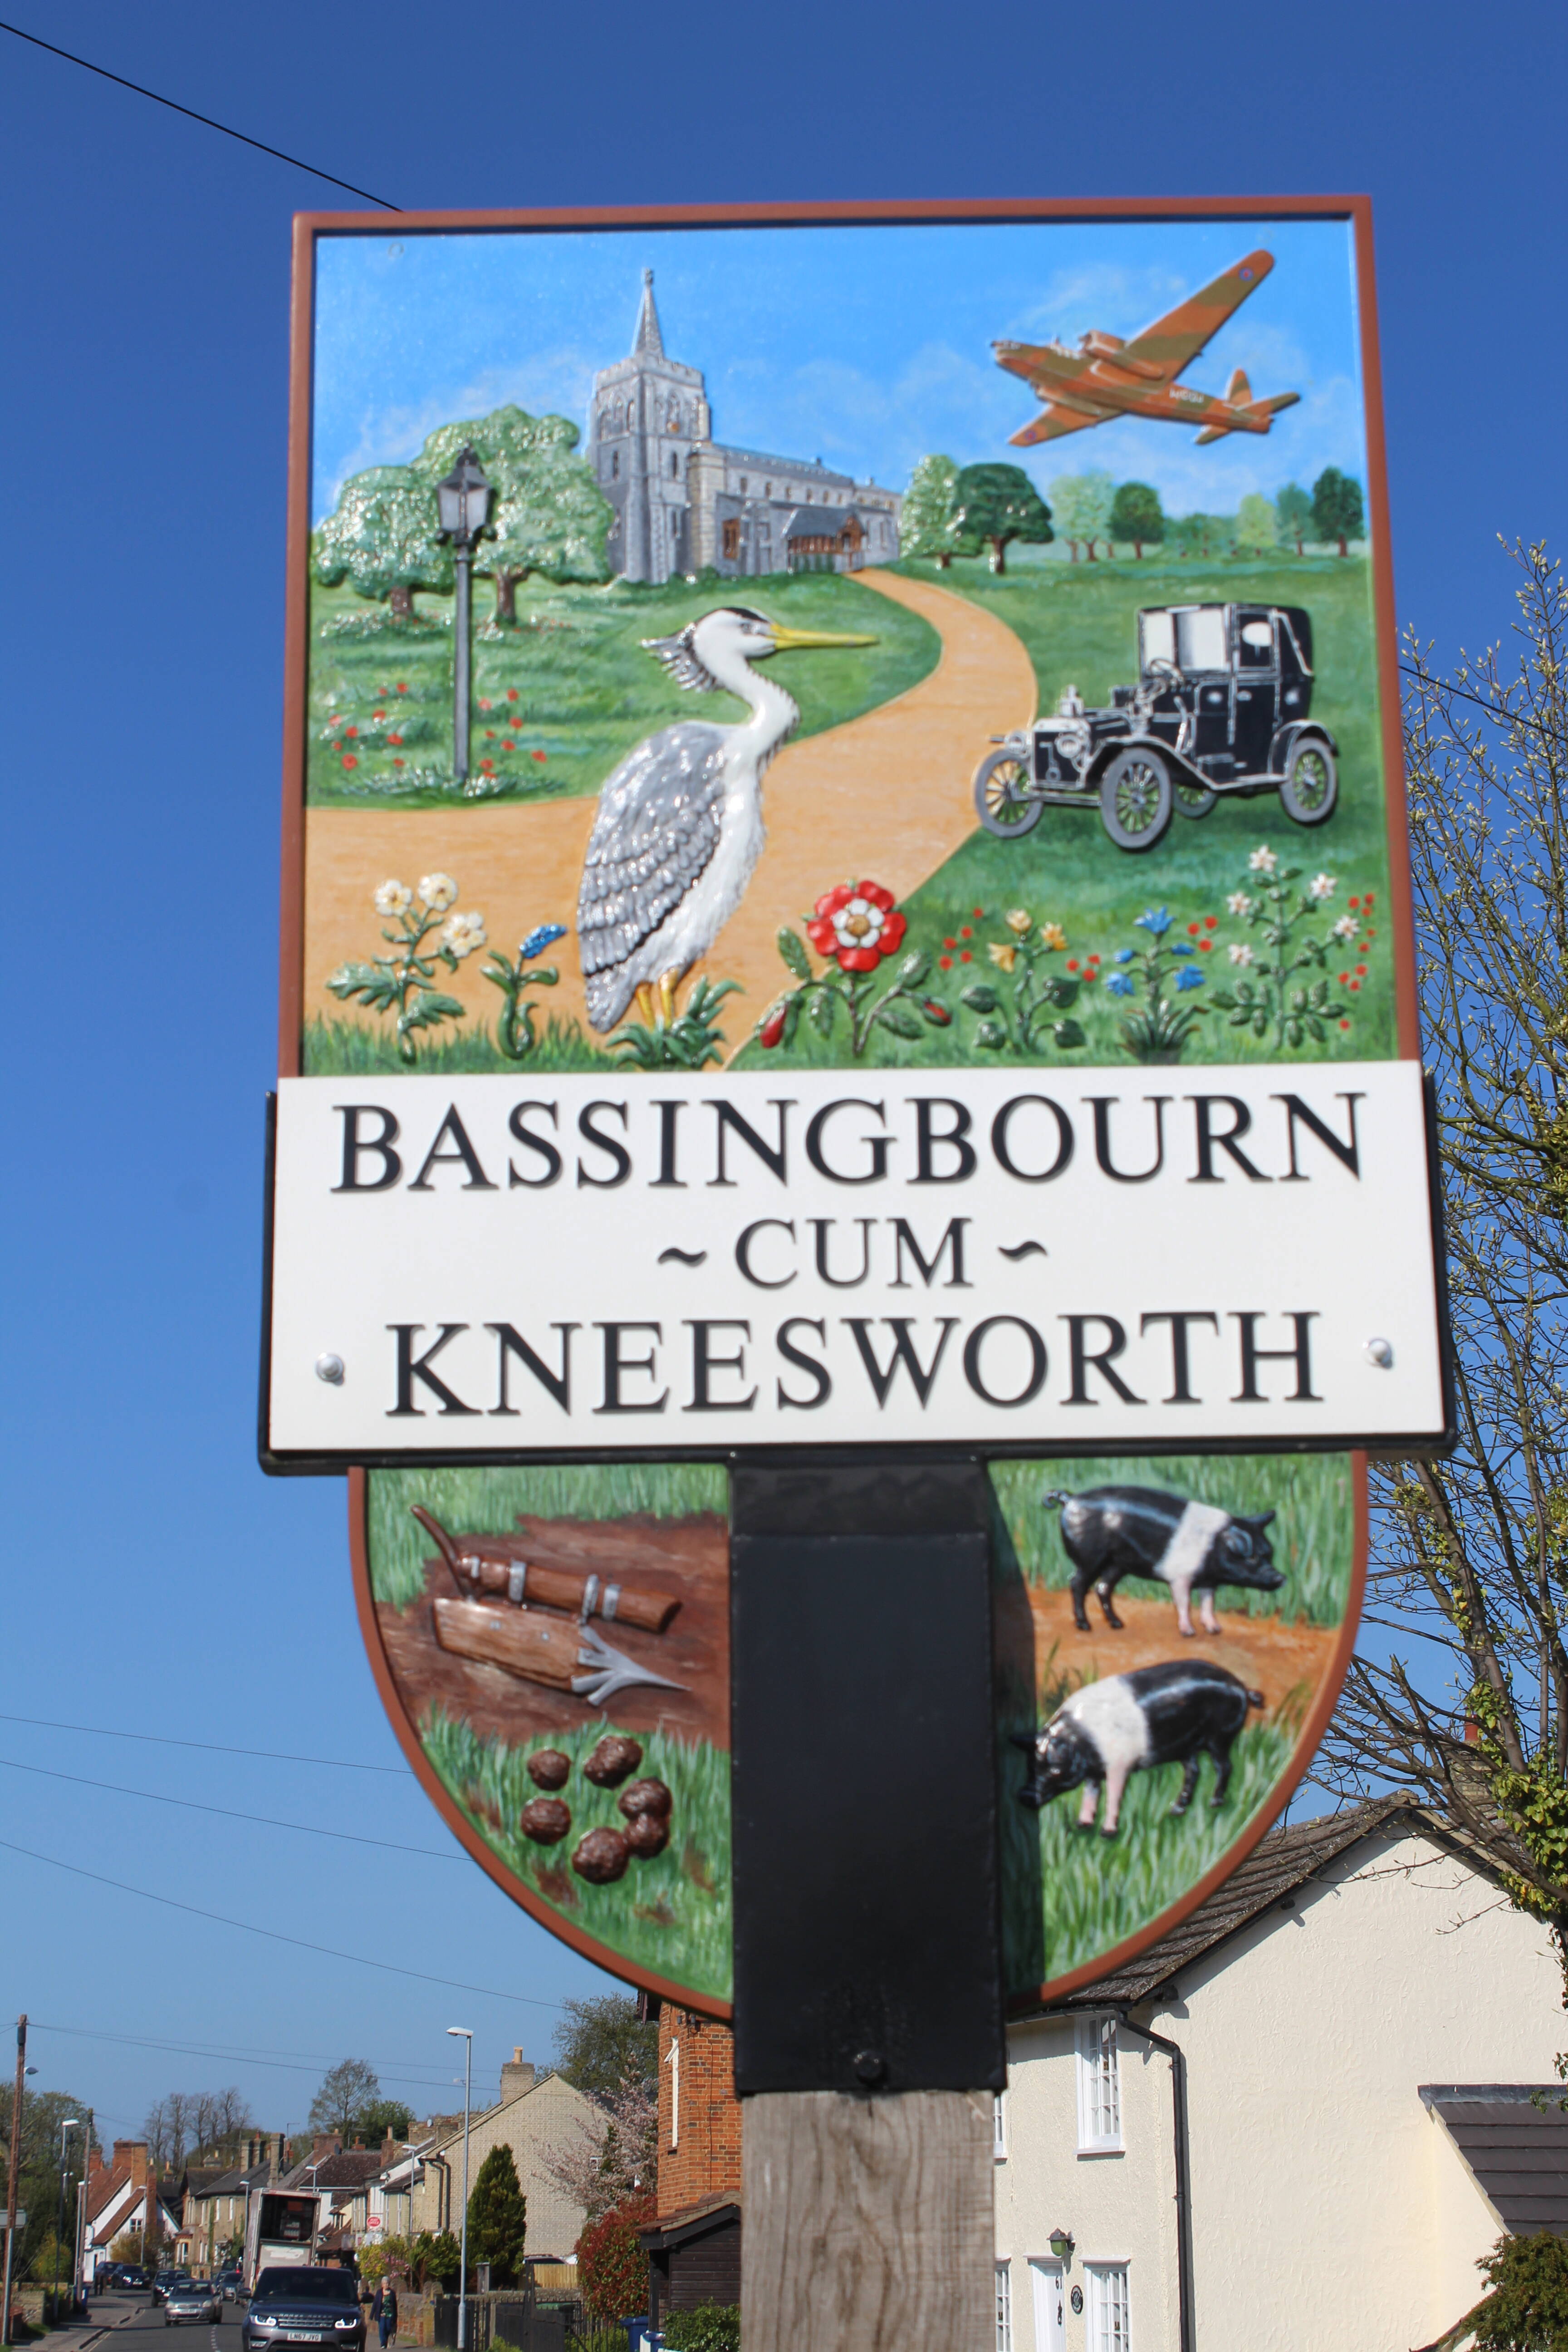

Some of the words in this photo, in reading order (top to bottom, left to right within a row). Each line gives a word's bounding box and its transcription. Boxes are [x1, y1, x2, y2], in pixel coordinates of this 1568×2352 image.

[331, 1092, 1366, 1193] BASSINGBOURN
[735, 1217, 971, 1289] CUM
[385, 1311, 1323, 1417] KNEESWORTH
